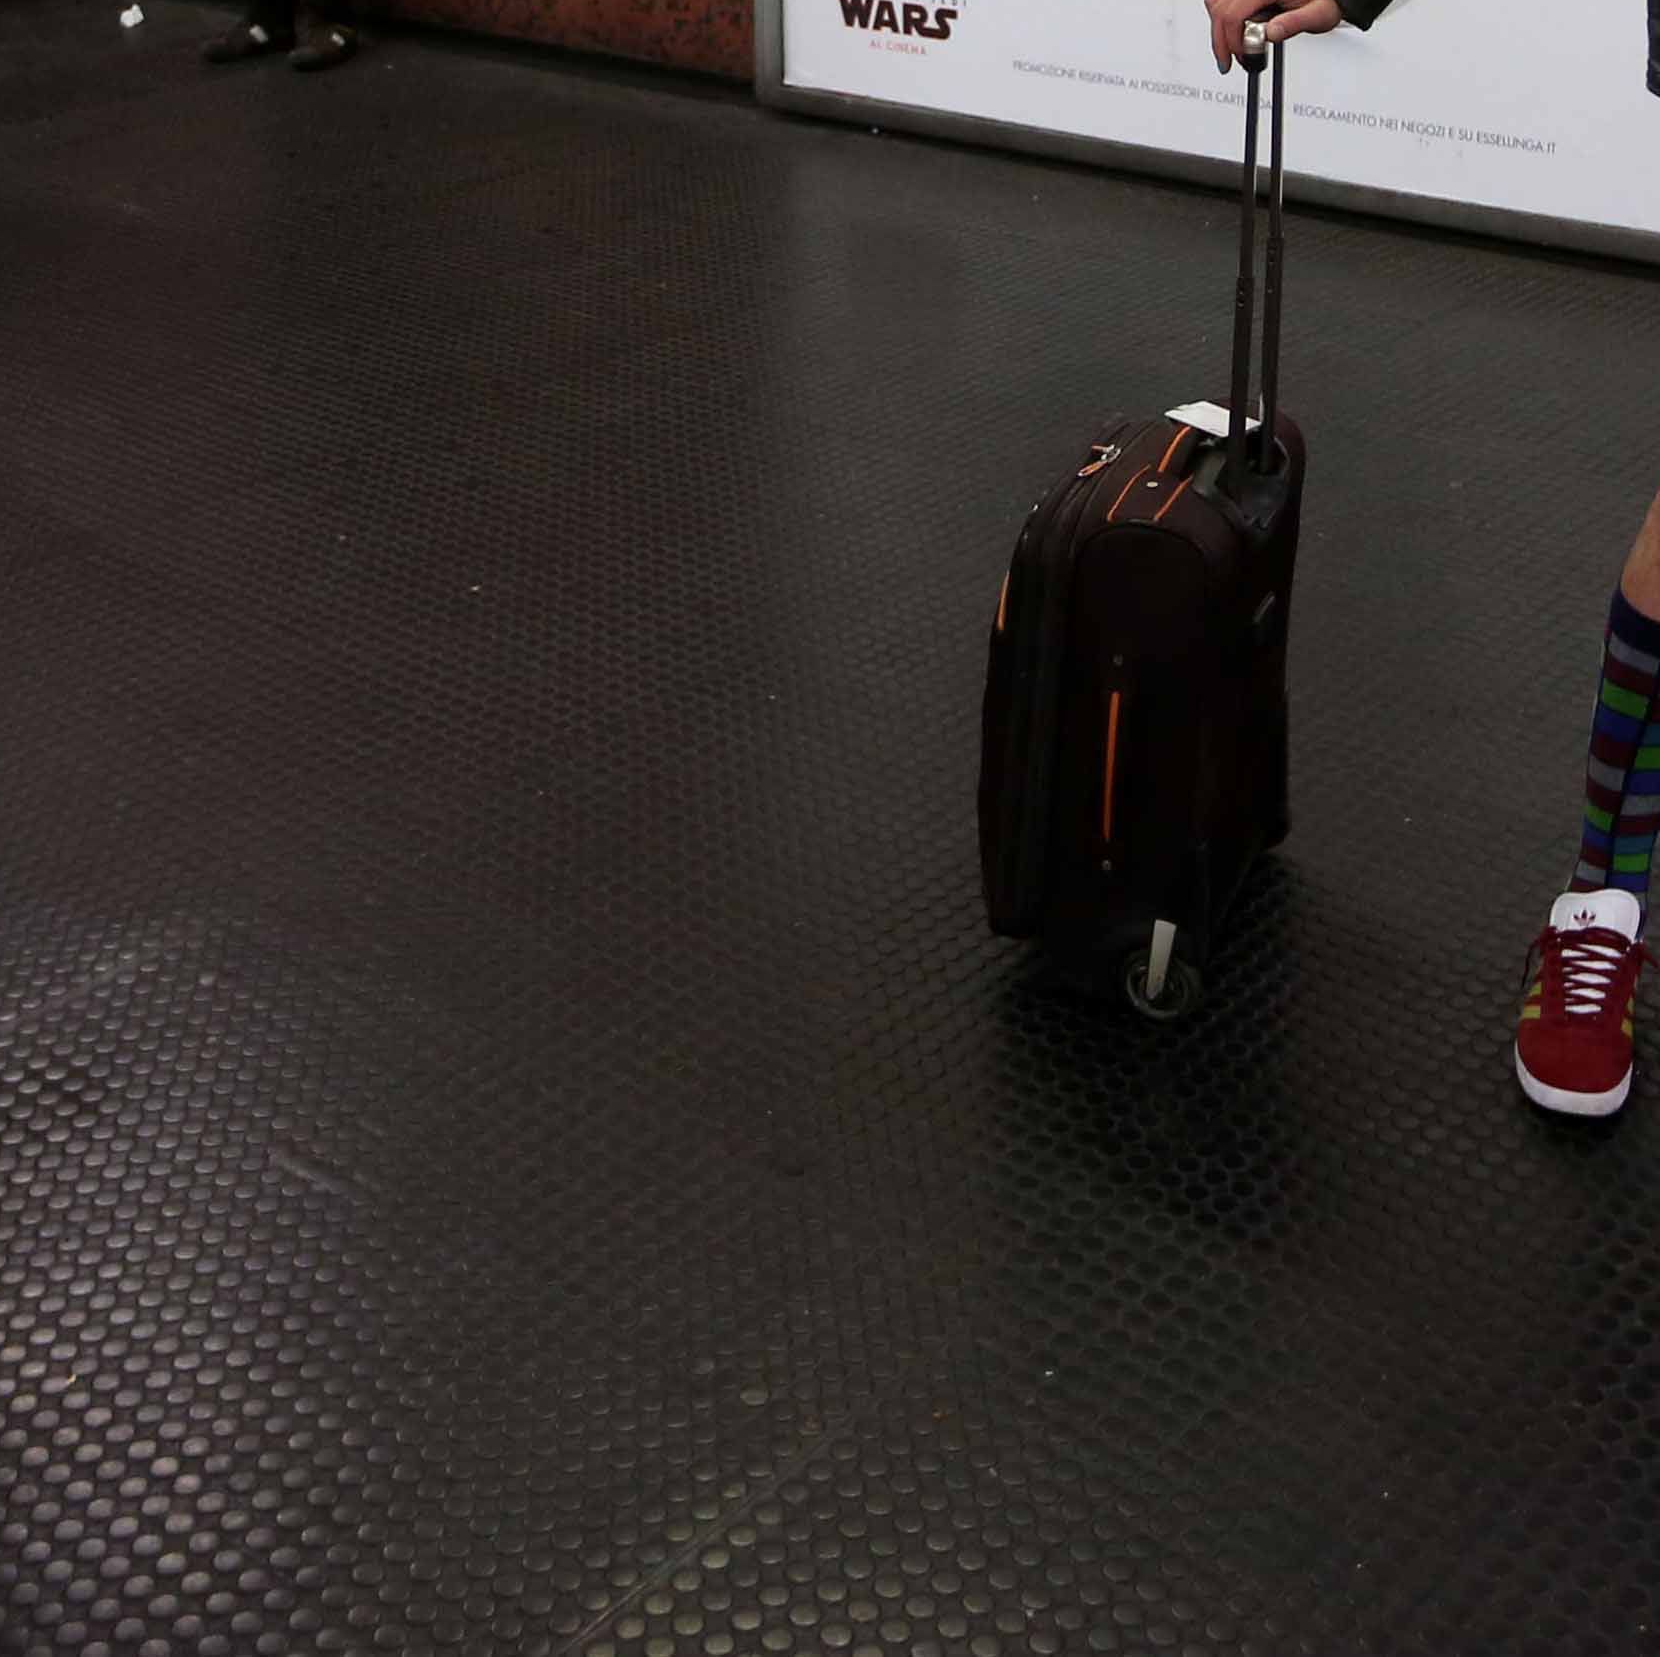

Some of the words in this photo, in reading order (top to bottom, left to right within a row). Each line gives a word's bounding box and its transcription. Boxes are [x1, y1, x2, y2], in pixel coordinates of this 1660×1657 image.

[1013, 60, 1077, 79] PROMOZIONE
[1140, 81, 1201, 100] POSSESSORI
[1293, 103, 1377, 127] REGOLAMENTO
[1400, 120, 1446, 138] NEGOZI
[1458, 129, 1473, 142] SU
